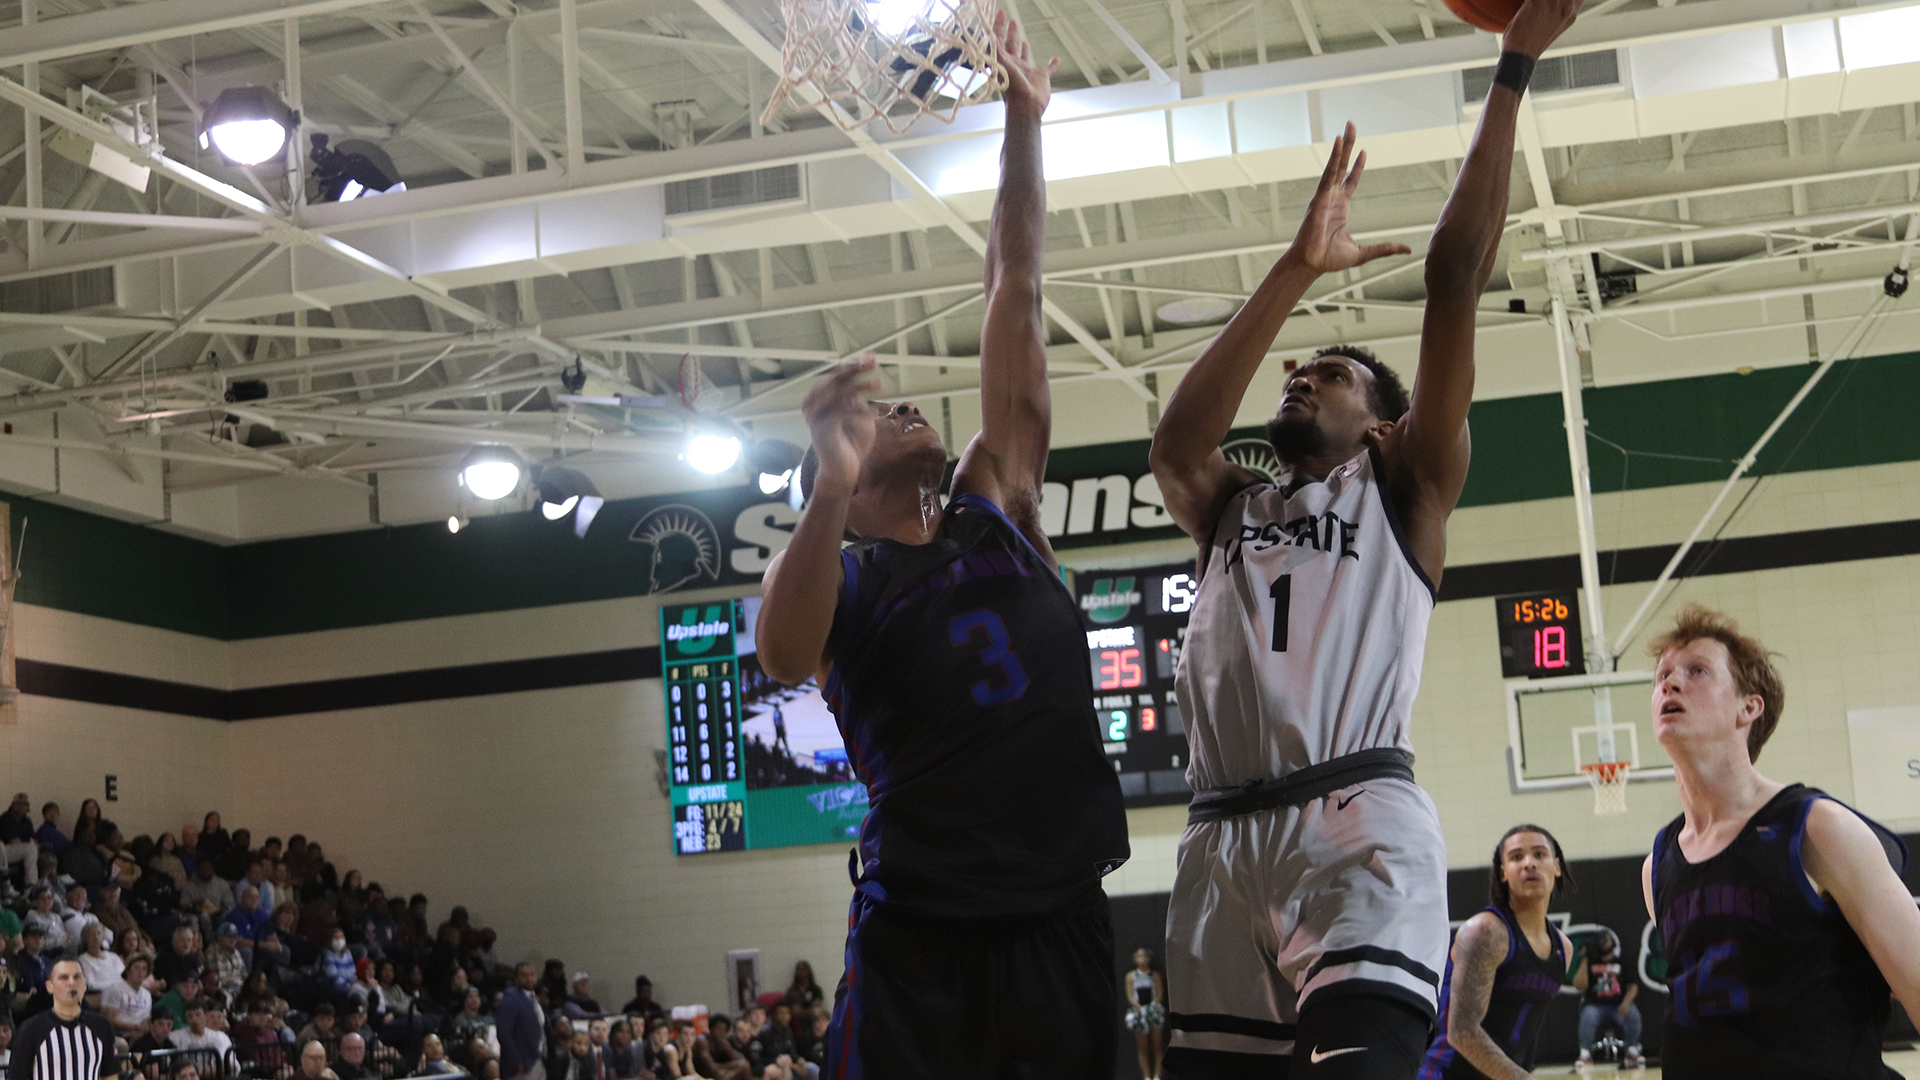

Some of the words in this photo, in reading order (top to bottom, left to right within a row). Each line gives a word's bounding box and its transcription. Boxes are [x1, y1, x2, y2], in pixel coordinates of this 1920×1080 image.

[1224, 511, 1359, 575] UPSTATE
[1269, 574, 1291, 652] 1
[1515, 598, 1569, 623] 15:26
[666, 621, 729, 641] Upstate
[948, 607, 1030, 708] 3
[1534, 626, 1566, 669] 18
[692, 664, 709, 678] PTS
[721, 662, 729, 675] F
[1100, 648, 1142, 690] 35
[671, 685, 681, 703] 0
[696, 683, 707, 700] 0
[722, 680, 732, 698] 3
[674, 705, 682, 722] 1
[697, 702, 708, 721] 0
[724, 701, 732, 718] 1
[1142, 707, 1155, 731] 3
[672, 725, 687, 743] 11
[699, 722, 709, 741] 6
[725, 720, 733, 738] 1
[1109, 710, 1128, 741] 2
[673, 745, 688, 763] 12
[700, 742, 710, 761] 9
[725, 740, 735, 759] 2
[674, 765, 689, 784] 14
[701, 763, 712, 782] 0
[726, 761, 737, 779] 2
[105, 774, 118, 801] E
[688, 784, 728, 803] UPSTATE
[685, 804, 704, 821] FG:
[681, 836, 706, 853] REB:
[706, 832, 721, 850] 23
[1674, 940, 1750, 1028] 15
